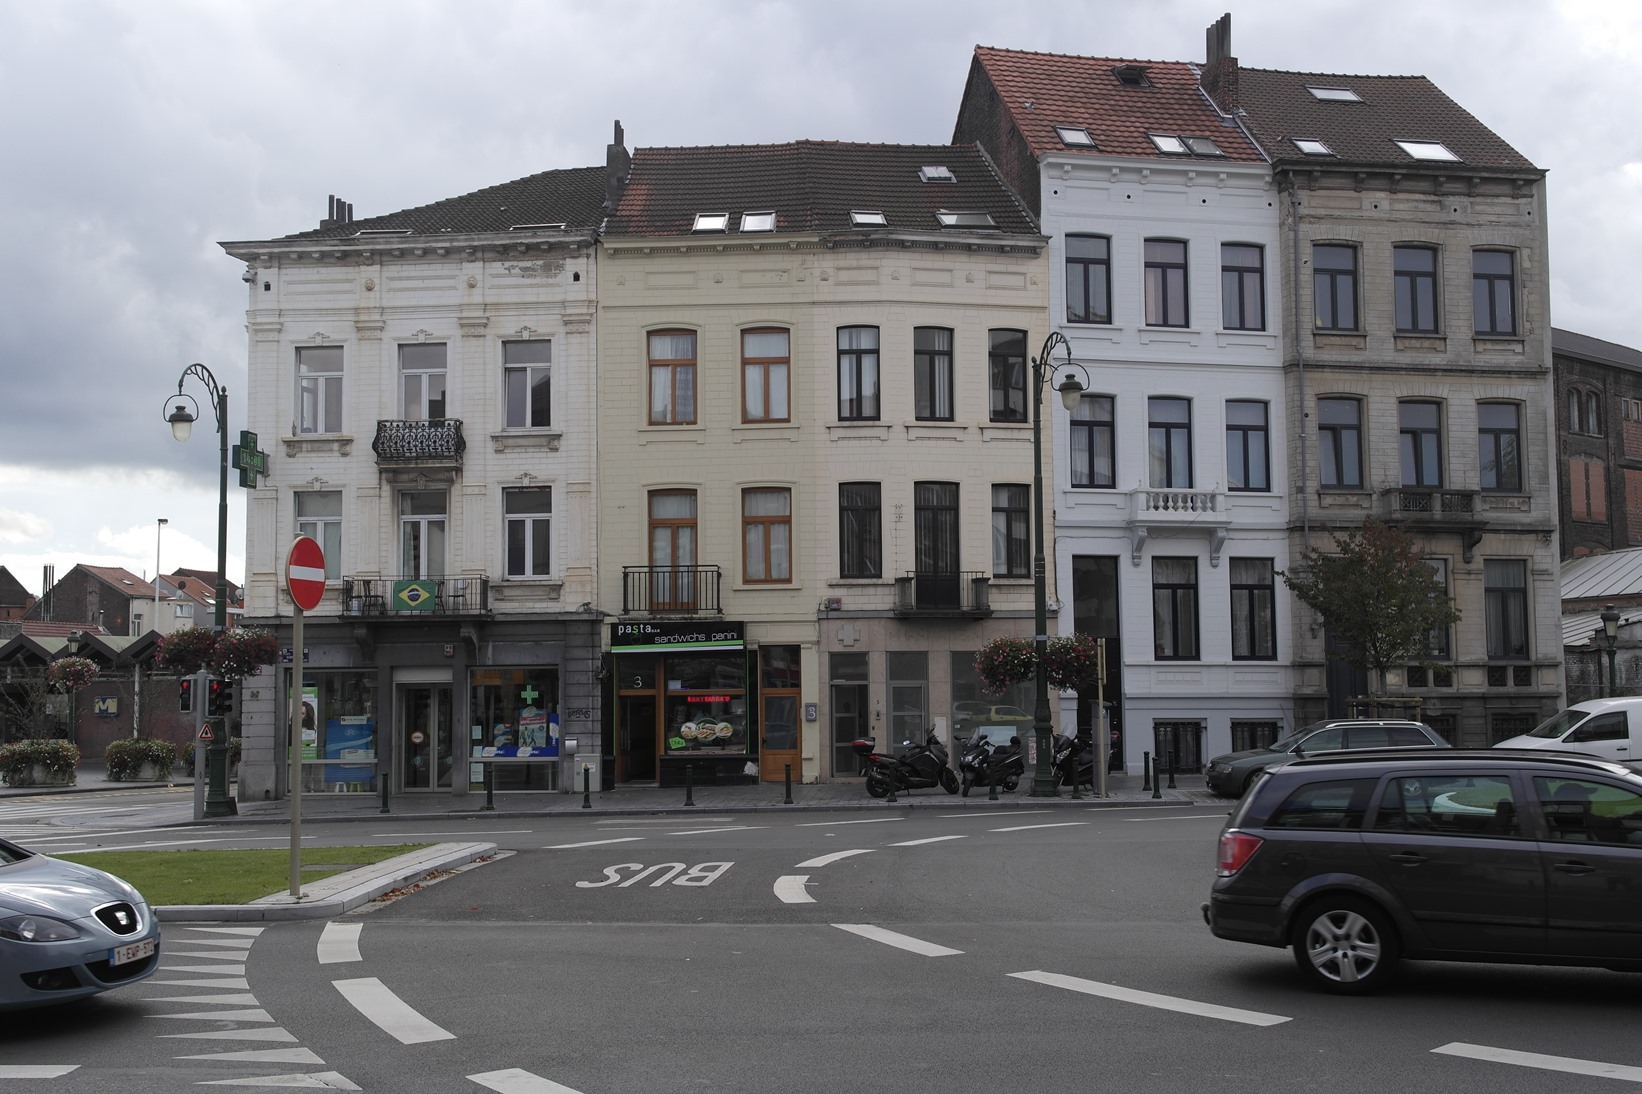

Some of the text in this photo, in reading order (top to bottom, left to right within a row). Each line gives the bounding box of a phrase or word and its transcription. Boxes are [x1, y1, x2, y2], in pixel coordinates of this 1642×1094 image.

[618, 624, 652, 636] pasta
[654, 630, 737, 644] sandwichs panini
[633, 676, 643, 688] 3
[807, 706, 816, 719] 3
[575, 861, 735, 888] BUS
